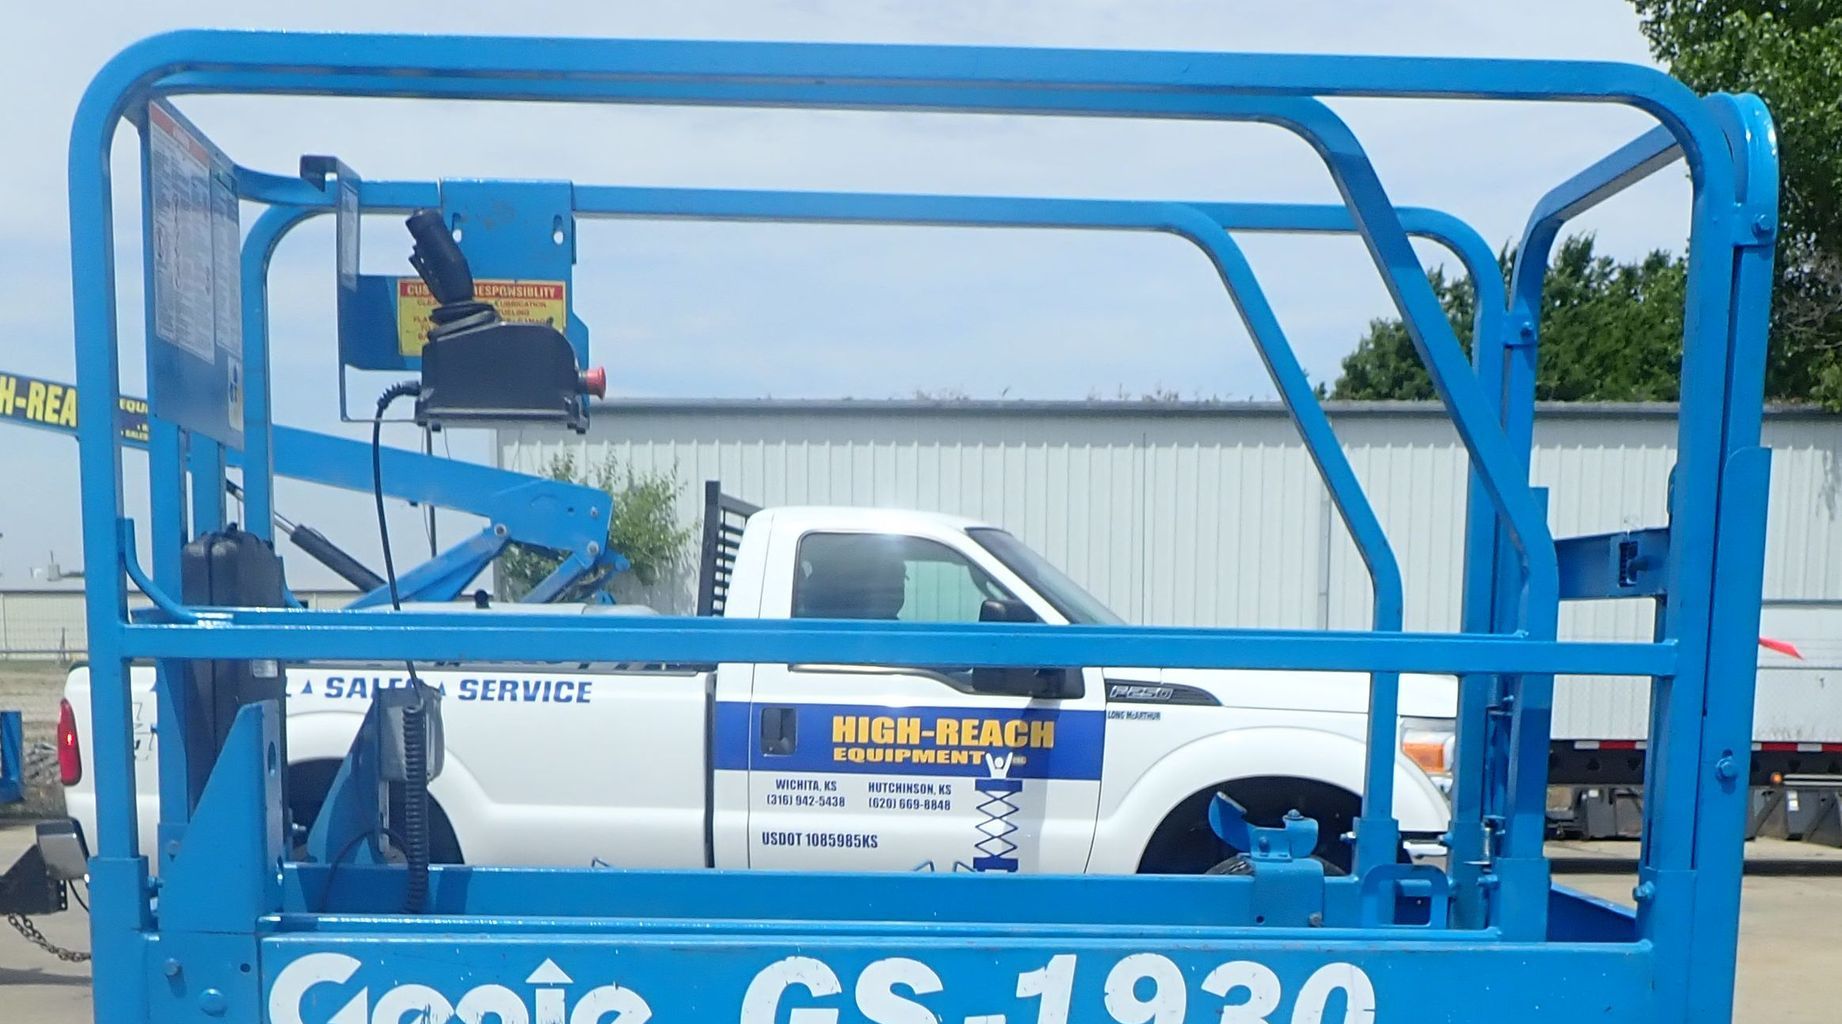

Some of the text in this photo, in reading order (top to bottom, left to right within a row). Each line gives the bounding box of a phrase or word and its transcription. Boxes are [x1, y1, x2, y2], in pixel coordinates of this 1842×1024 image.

[0, 374, 77, 428] H-REA
[458, 679, 592, 704] SERVICE
[832, 715, 1055, 748] HIGH-REACH
[833, 747, 986, 765] EQUIPMENT
[775, 779, 838, 792] WICHITA, KS
[939, 784, 952, 796] KS
[767, 794, 846, 808] (316) 942-5438
[868, 797, 897, 810] (620)
[762, 832, 879, 848] USDOT 1085985KS
